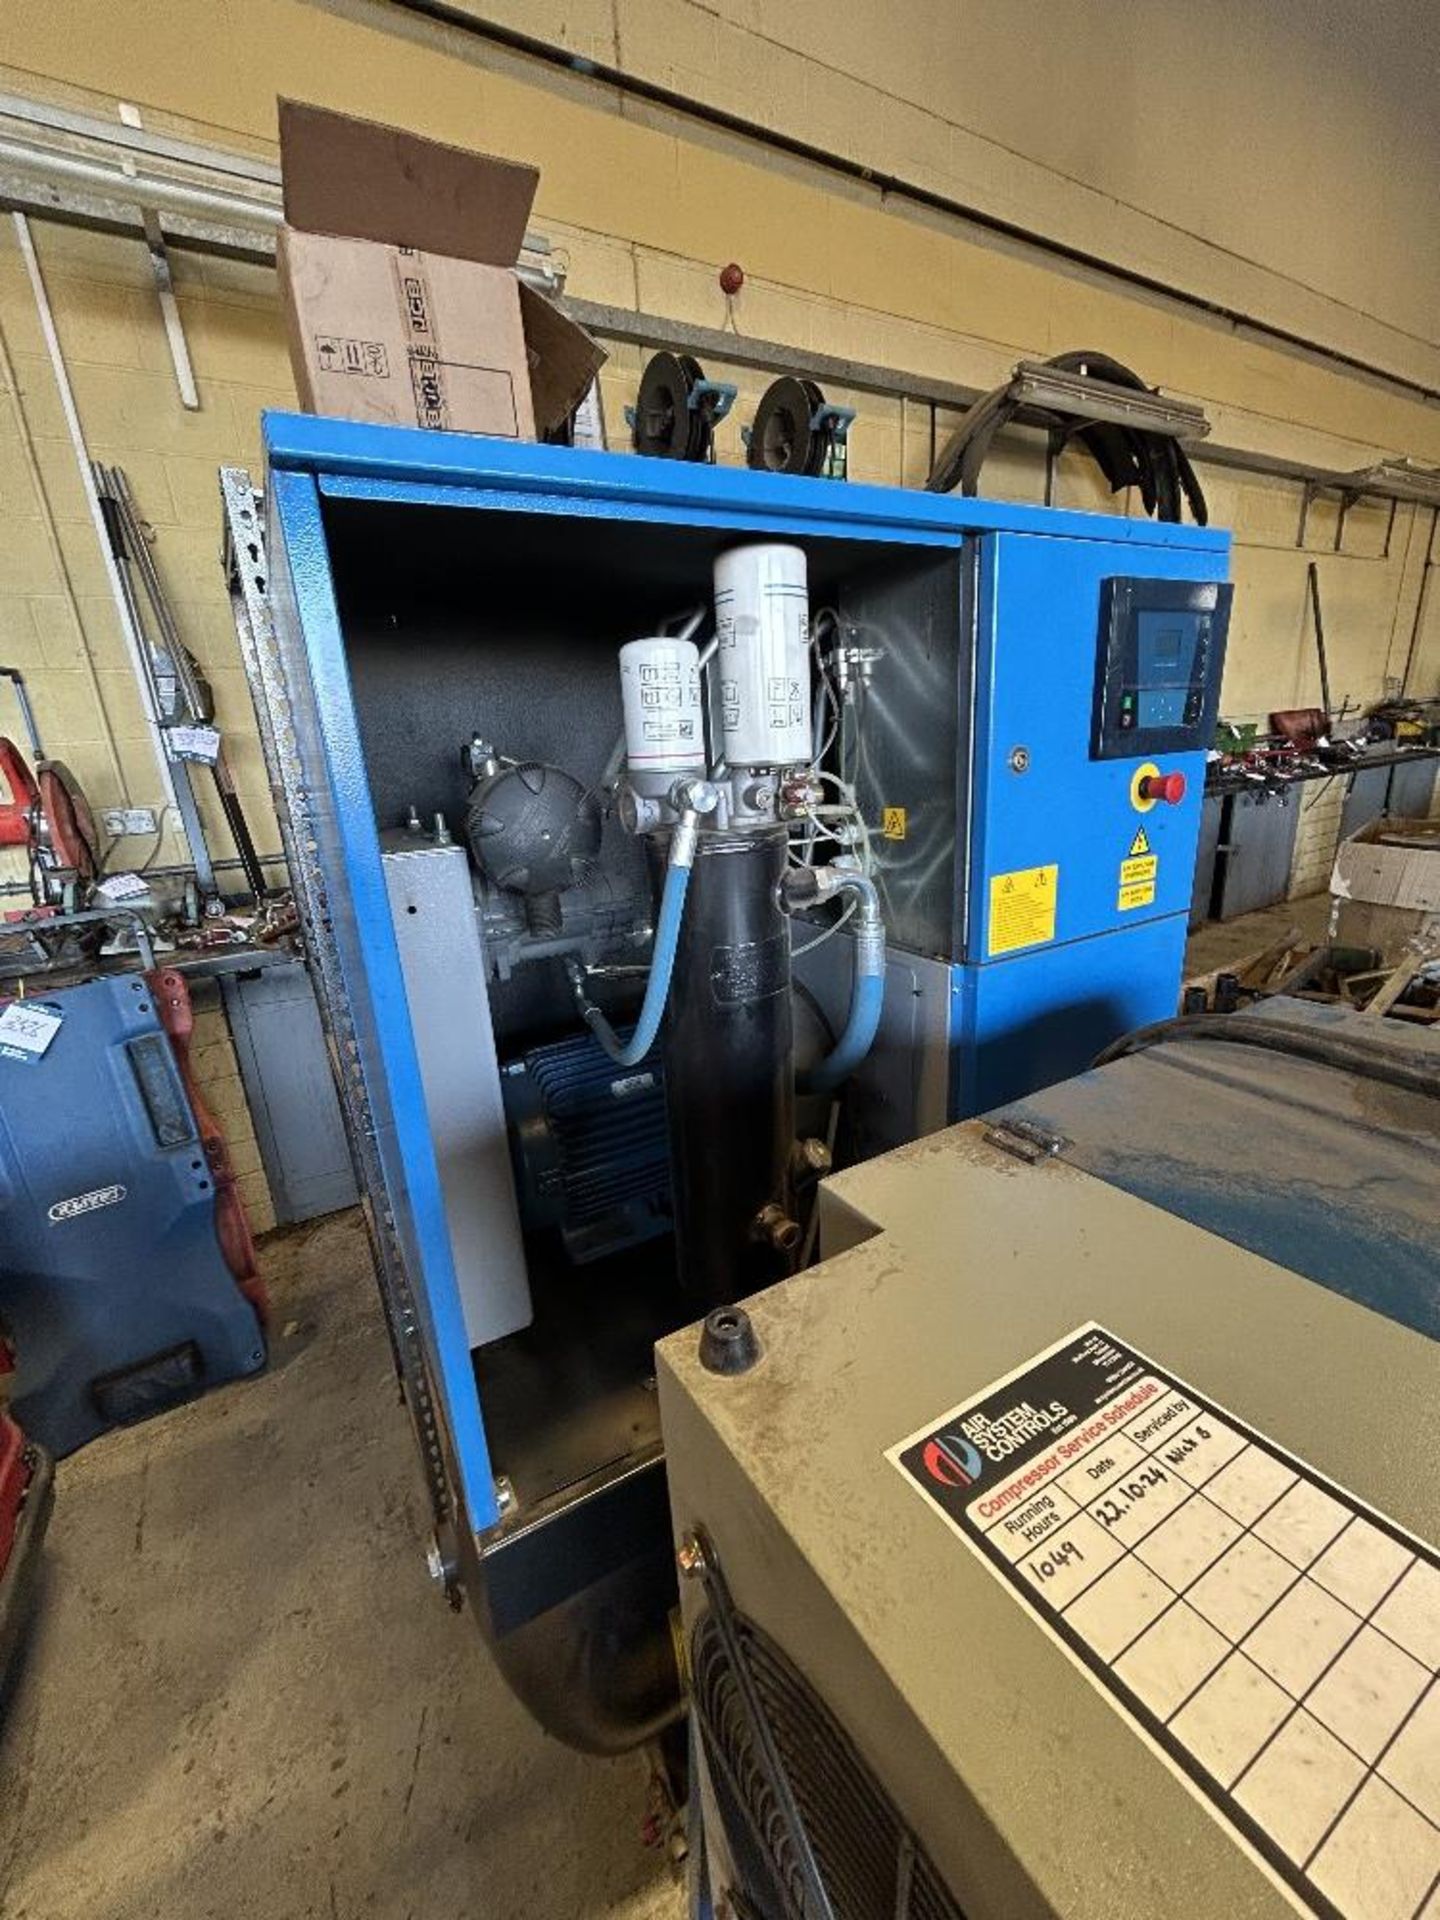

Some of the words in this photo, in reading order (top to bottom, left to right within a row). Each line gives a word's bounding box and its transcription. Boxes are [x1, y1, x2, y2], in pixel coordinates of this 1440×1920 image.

[960, 1413, 991, 1439] AIR
[972, 1402, 1037, 1449] SYSTEM
[986, 1401, 1068, 1462] CONTROLS
[1134, 1405, 1179, 1442] Serviced
[1175, 1399, 1191, 1415] by
[977, 1454, 1061, 1519] Compressor
[1057, 1419, 1108, 1458] Service
[1102, 1382, 1158, 1426] Schedule
[1086, 1456, 1116, 1480] Date
[1003, 1495, 1056, 1535] Running
[1020, 1510, 1061, 1543] Hours
[1028, 1540, 1085, 1584] 1049
